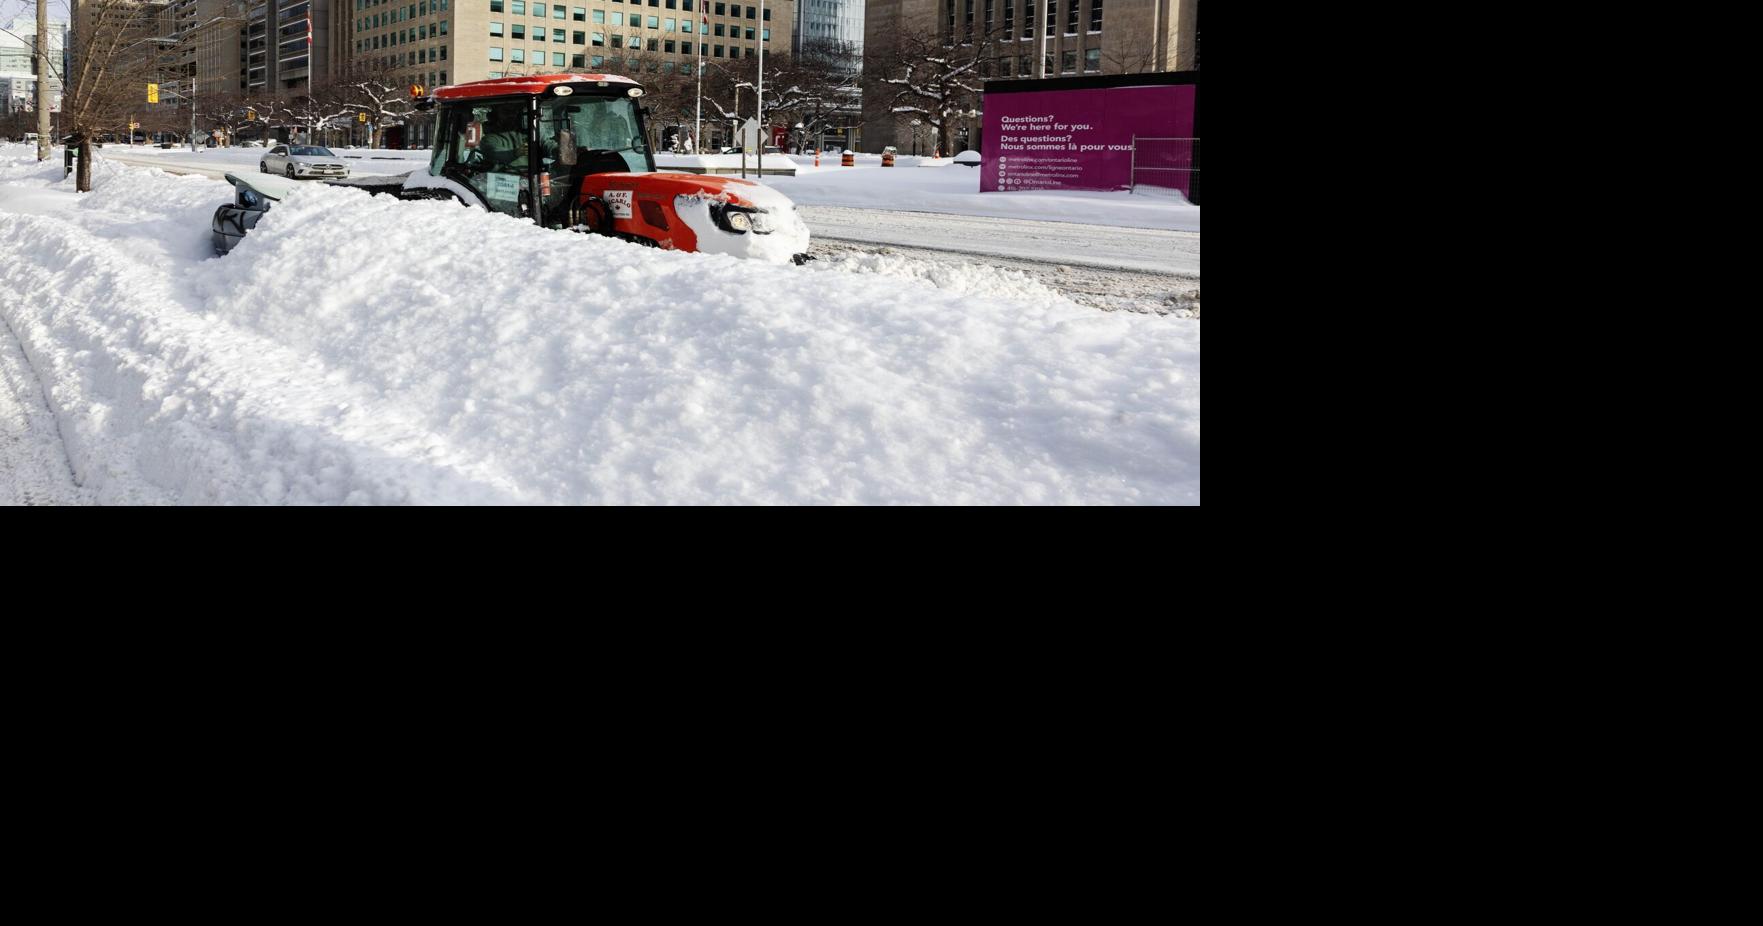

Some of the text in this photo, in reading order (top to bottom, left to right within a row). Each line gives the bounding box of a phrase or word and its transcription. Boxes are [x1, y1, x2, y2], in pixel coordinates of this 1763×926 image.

[1001, 115, 1054, 123] Questions?
[1071, 124, 1093, 132] you.
[1020, 135, 1072, 144] questions?
[1080, 144, 1105, 152] pour
[608, 198, 631, 208] ICARLO
